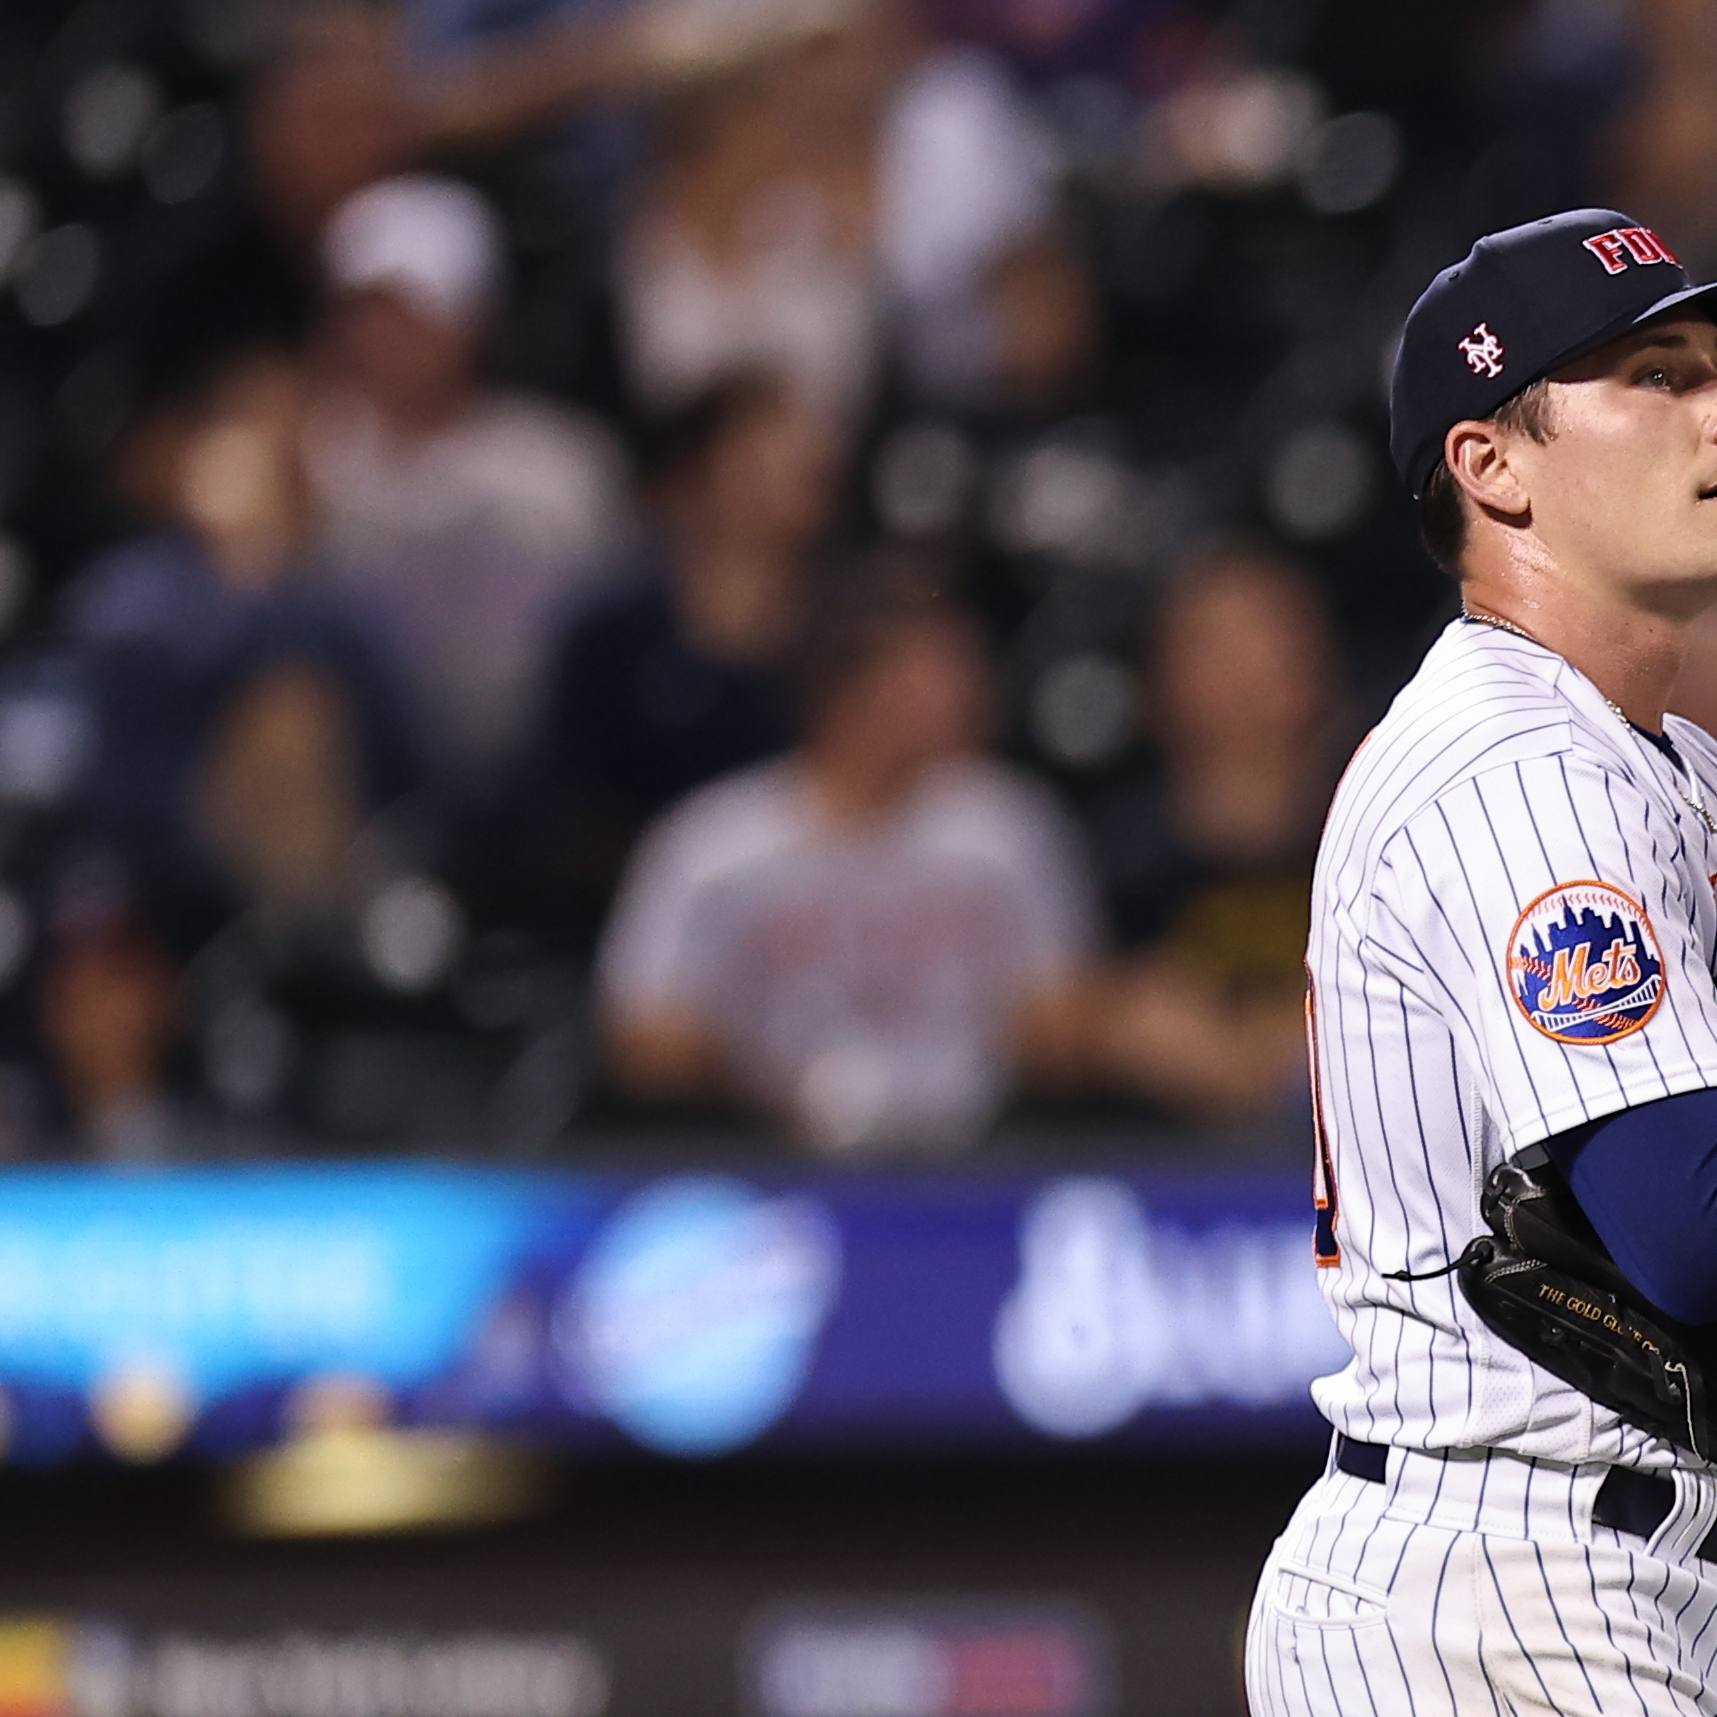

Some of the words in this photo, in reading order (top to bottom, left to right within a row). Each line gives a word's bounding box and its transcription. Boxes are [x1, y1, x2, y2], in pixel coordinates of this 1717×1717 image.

[1538, 939, 1641, 1011] Mets
[1538, 1283, 1567, 1306] THE
[1566, 1296, 1602, 1321] GOLD
